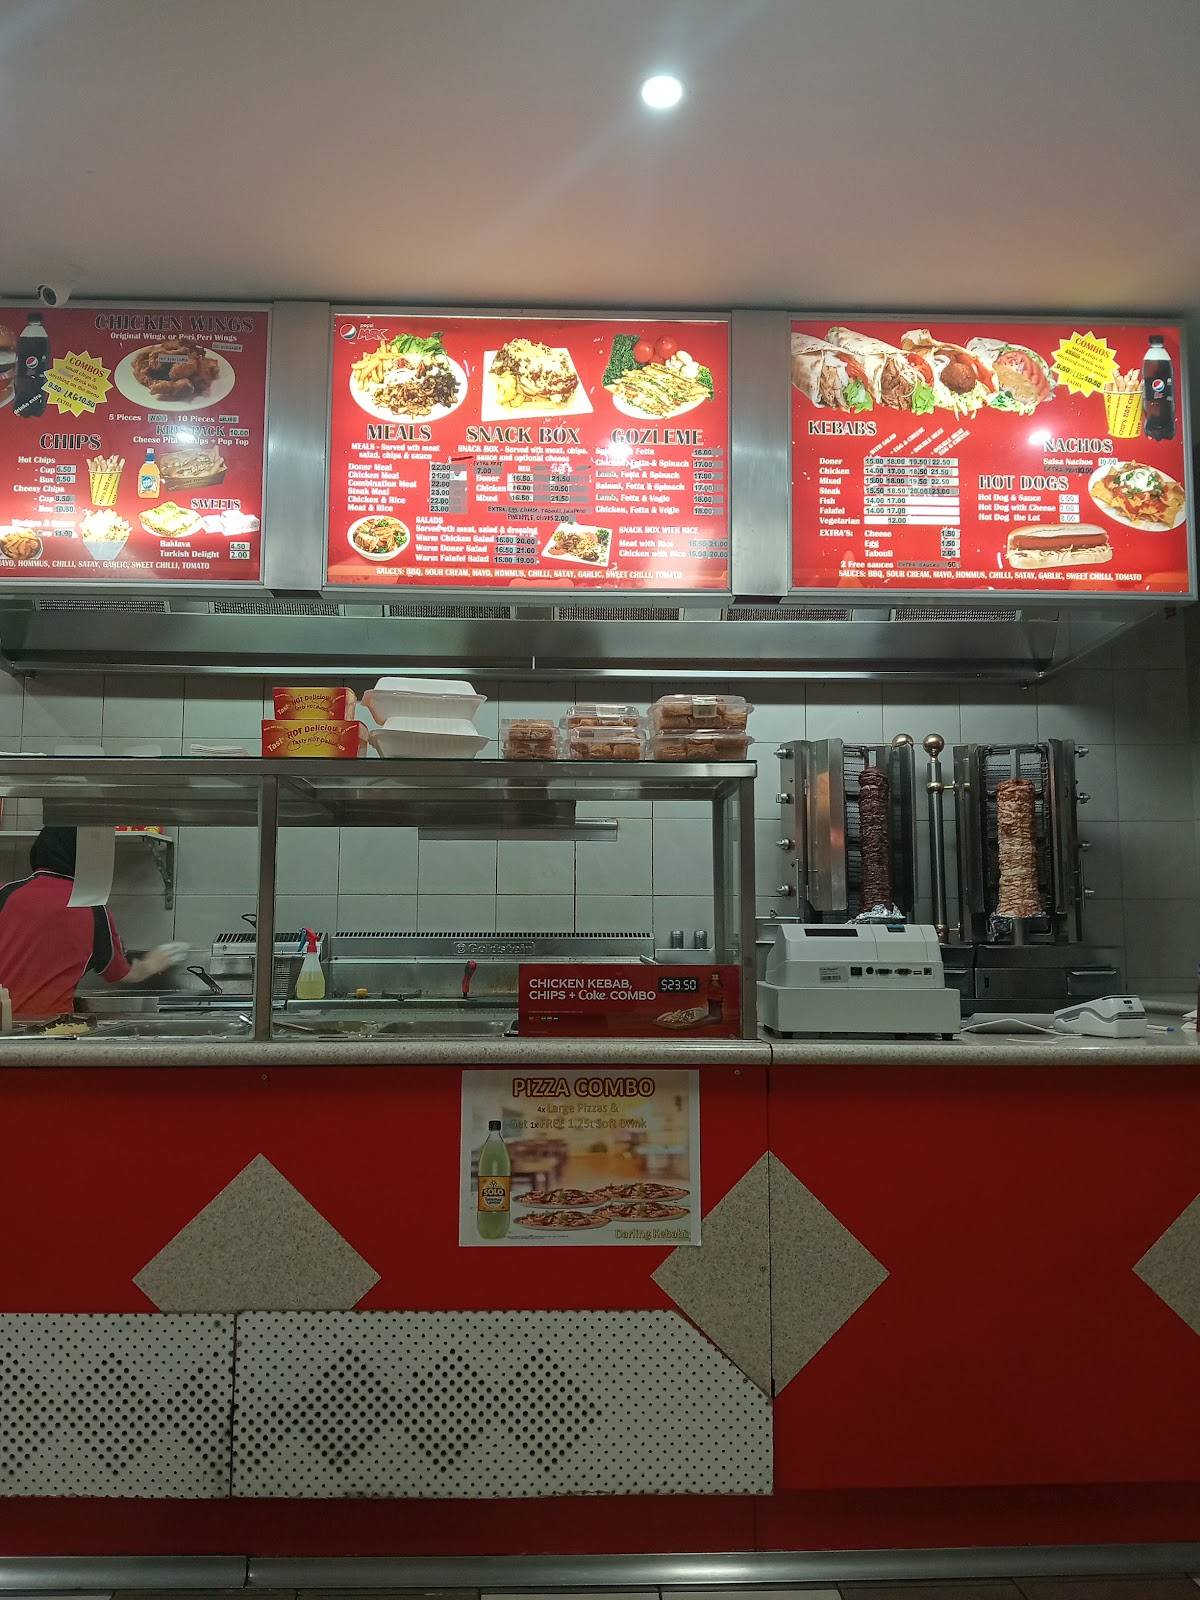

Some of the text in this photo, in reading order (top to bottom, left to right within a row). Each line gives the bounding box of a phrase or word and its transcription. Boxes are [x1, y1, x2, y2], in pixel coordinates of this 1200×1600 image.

[95, 313, 254, 333] CHICKEN WINGS
[110, 332, 141, 340] Original
[143, 332, 166, 341] Wings
[214, 334, 238, 342] Wings
[1075, 337, 1111, 359] COMBOS
[69, 358, 105, 377] COMBOS
[190, 415, 215, 423] Pieces
[367, 424, 432, 441] MEALS
[808, 420, 877, 436] KEBABS
[466, 425, 581, 444] SNACK BOX
[611, 428, 705, 446] GOZLEME
[40, 433, 102, 450] CHIPS
[1044, 438, 1114, 453] NACHOS
[381, 443, 406, 451] Served
[18, 456, 56, 465] Hot Chips
[382, 452, 402, 460] chips
[659, 460, 690, 468] Spinach
[819, 457, 843, 465] Doner
[1065, 458, 1093, 466] Nachos
[39, 466, 56, 474] Cup
[649, 471, 680, 479] Spinach
[819, 477, 842, 485] Mixed
[978, 475, 1069, 491] HOT DOGS
[13, 485, 41, 493] Cheesy
[819, 487, 841, 495] Steak
[620, 494, 640, 502] Fetta
[978, 494, 1042, 504] Hot Dog Sauce
[190, 498, 241, 510] SWEETS
[819, 507, 846, 515] Falafel
[978, 504, 1056, 514] Hot Dog with Cheese
[415, 516, 444, 524] SALADS
[819, 516, 861, 526] Vegetarian
[978, 514, 1041, 524] Hot Dog the Lot
[415, 534, 439, 542] Warm
[819, 529, 853, 537] EXTRA'S:
[864, 530, 892, 538] Cheese
[160, 540, 191, 548] Baklava
[415, 544, 439, 552] Warm
[864, 540, 880, 549] Egg
[160, 550, 190, 558] Turkish
[191, 551, 220, 560] Delight
[864, 550, 893, 558] Tabouli
[182, 562, 210, 570] TOMATO
[848, 561, 865, 569] Free
[867, 561, 894, 569] sauces
[445, 568, 470, 576] CREAM,
[528, 569, 552, 578] CHILLI,
[906, 570, 932, 578] CREAM,
[1089, 572, 1114, 581] CHILLI,
[1115, 573, 1142, 581] TOMATO
[287, 727, 302, 738] HOT
[529, 979, 697, 991] CHICKEN KEBAB, $23.50
[529, 991, 566, 1000] CHIPS
[578, 990, 605, 1000] Coke
[610, 991, 656, 1000] COMBO
[513, 1077, 655, 1097] PIZZA COMBO
[547, 1103, 575, 1115] Large
[578, 1103, 607, 1113] Pizzas
[538, 1119, 565, 1128] FREE
[482, 1188, 504, 1196] SOLO
[615, 1229, 651, 1241] Darling
